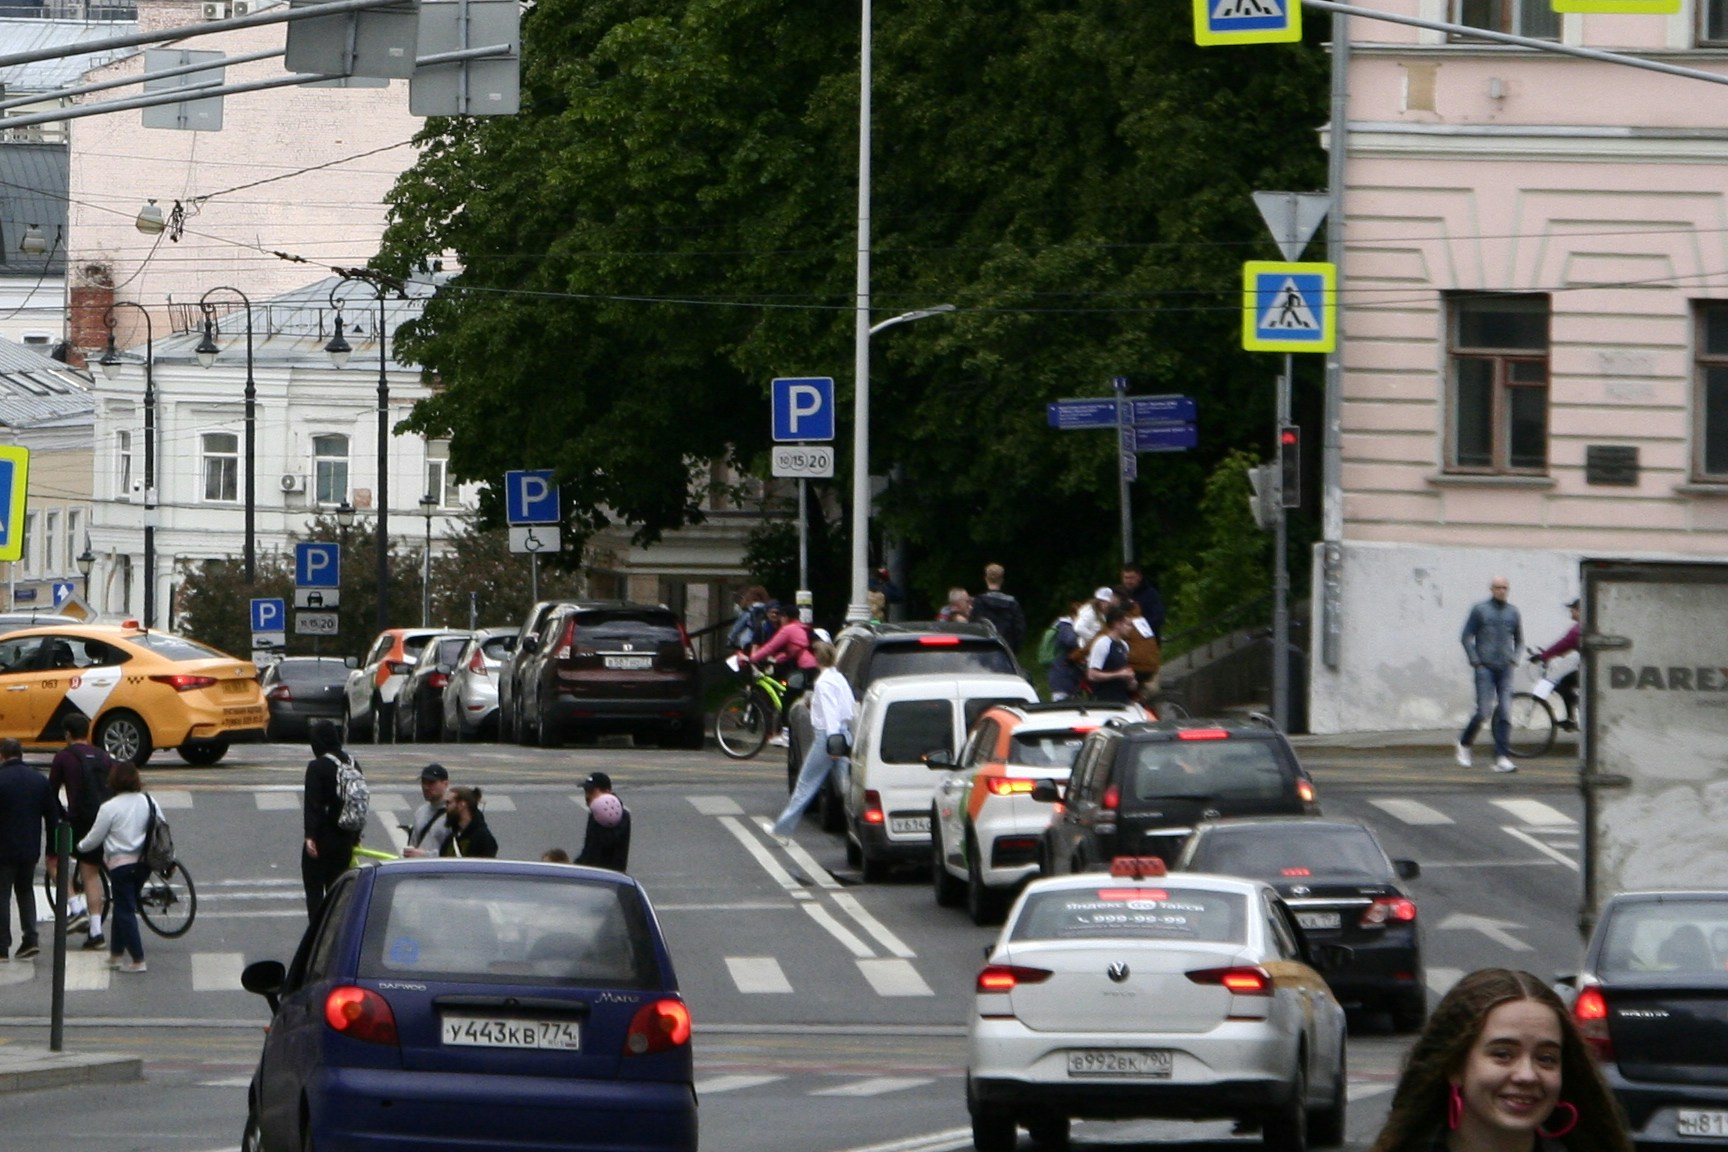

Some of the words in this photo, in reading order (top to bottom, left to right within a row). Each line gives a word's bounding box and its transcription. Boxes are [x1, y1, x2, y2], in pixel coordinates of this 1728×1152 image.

[789, 385, 822, 433] P
[792, 455, 804, 467] 15
[809, 455, 827, 468] 20
[521, 476, 548, 517] P
[307, 549, 329, 581] P
[259, 603, 276, 627] P
[321, 619, 333, 628] 20
[540, 1023, 572, 1041] 774
